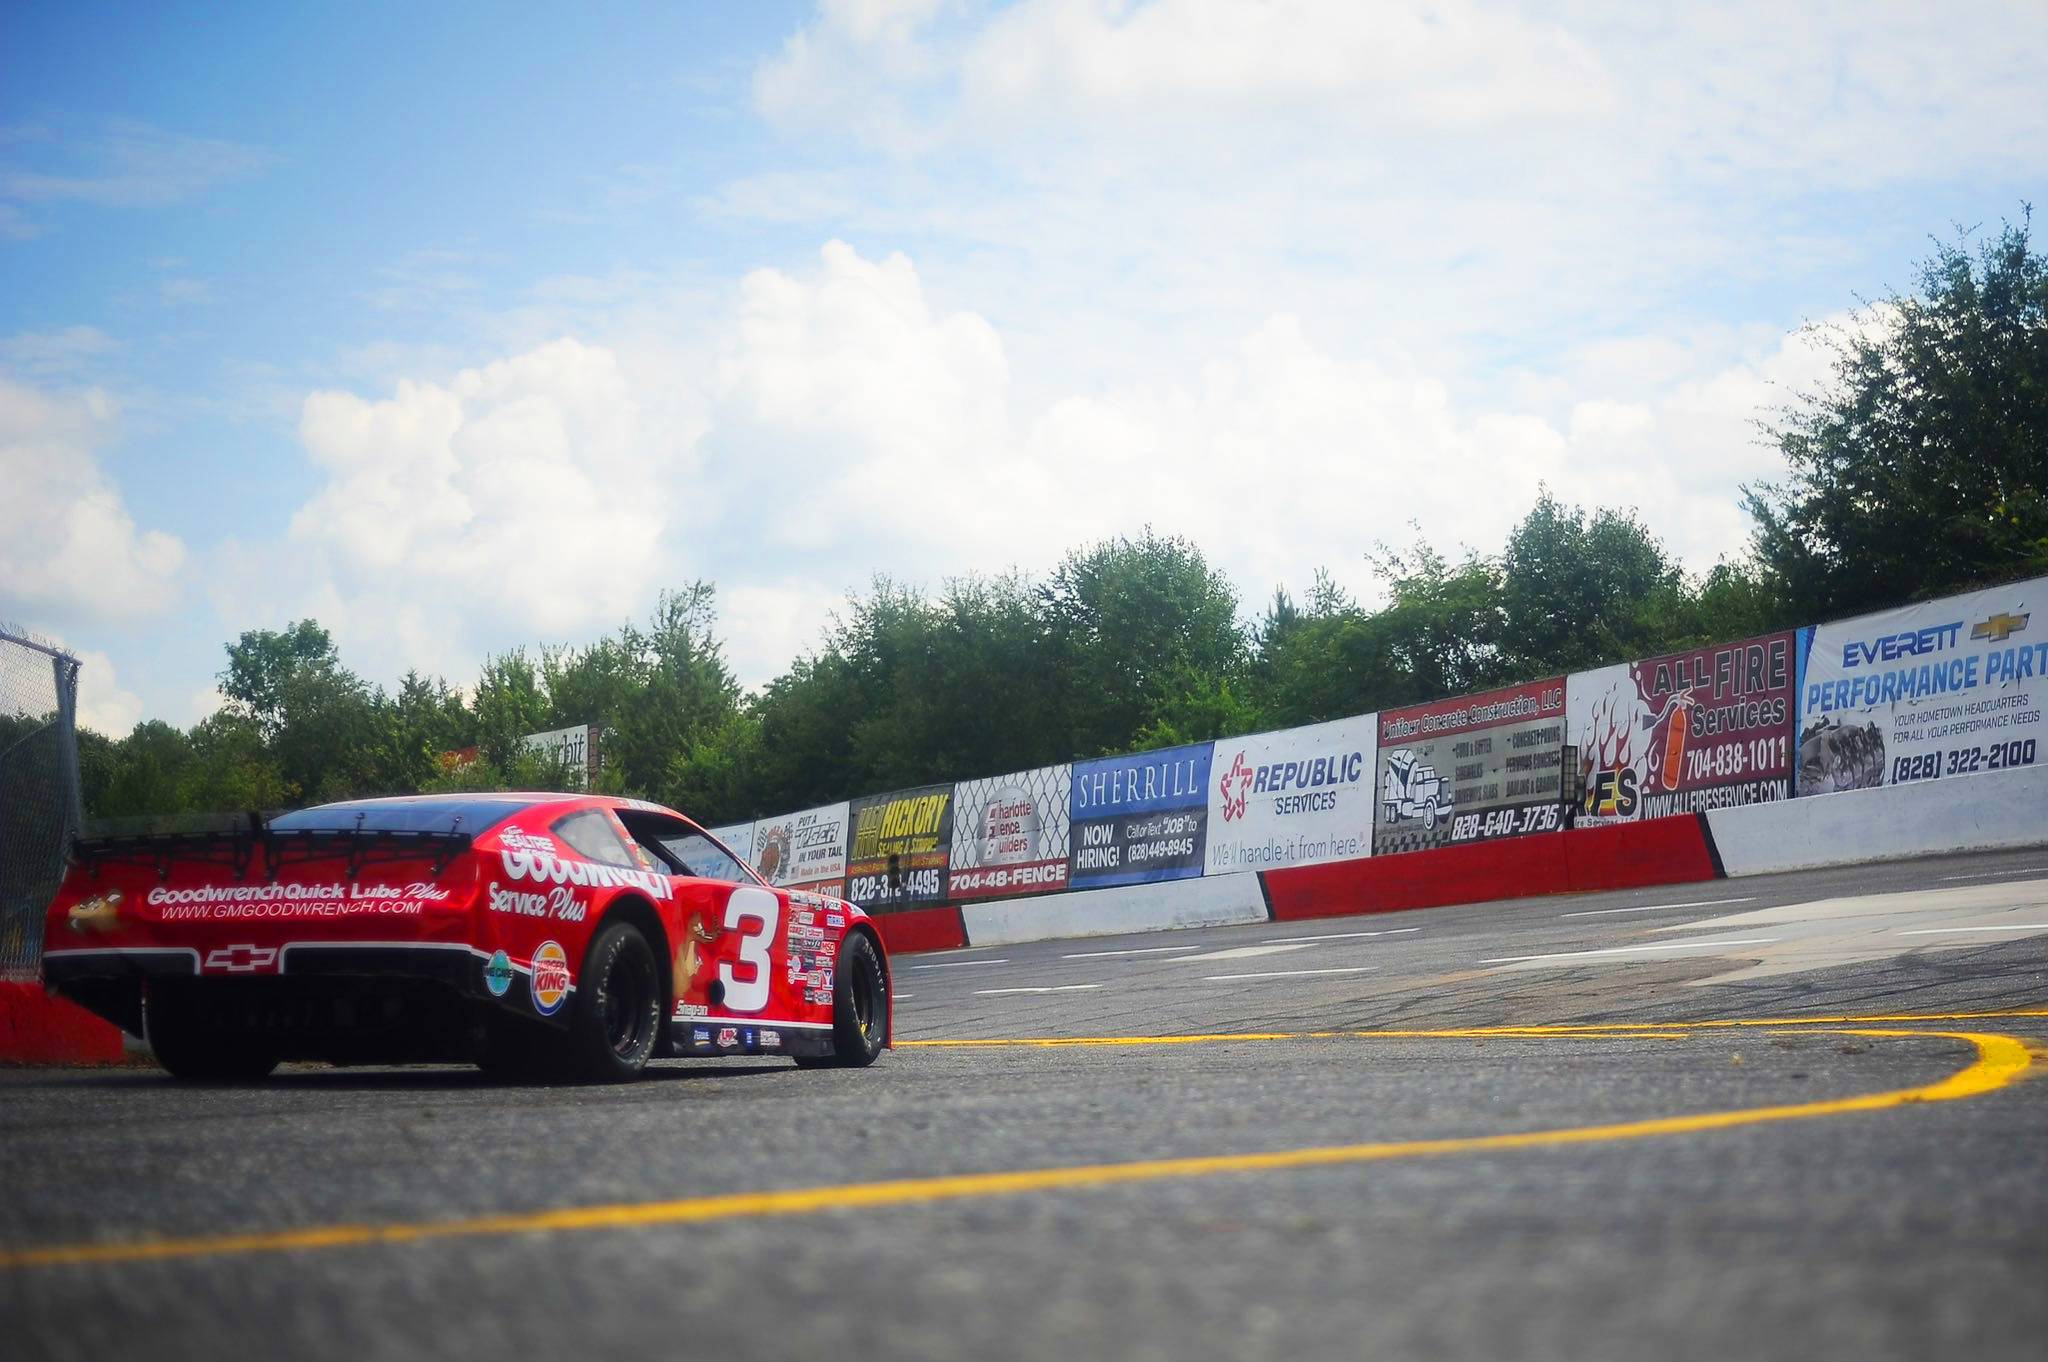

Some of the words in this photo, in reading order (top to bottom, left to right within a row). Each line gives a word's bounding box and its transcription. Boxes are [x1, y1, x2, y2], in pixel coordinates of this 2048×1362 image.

[1843, 621, 1964, 668] EVERETT
[1807, 655, 1980, 714] PERFORMANCE
[1383, 717, 1420, 741] Unifour
[1421, 710, 1468, 733] Concrete
[1470, 695, 1540, 725] Construction,
[1542, 688, 1562, 711] LLC
[1691, 696, 1785, 738] Services
[1894, 712, 1916, 727] YOUR
[1917, 705, 1963, 722] HOMETOWN
[1964, 694, 2029, 716] HEADQUARTERS
[1893, 730, 1909, 744] FOR
[1911, 728, 1925, 741] ALL
[1927, 724, 1949, 739] YOUR
[1950, 715, 2008, 736] PERFORMANCE
[2010, 710, 2041, 725] NEEDS
[1253, 752, 1362, 793] REPUBLIC
[1686, 736, 1786, 781] 704-838-1011
[1947, 739, 2037, 775] 322-2100
[1080, 760, 1198, 808] SHERRILL
[880, 794, 949, 839] HICKORY
[1275, 791, 1336, 815] SERVICES
[795, 822, 841, 849] TIGER
[798, 816, 810, 827] PUT
[812, 814, 817, 824] A
[1084, 824, 1114, 846] NOW
[1147, 822, 1161, 836] Text
[1189, 819, 1198, 831] to
[799, 852, 806, 862] IN
[808, 849, 826, 860] YOUR
[828, 846, 842, 857] TAIL
[1077, 846, 1120, 869] HIRING!
[1240, 838, 1282, 864] handle
[1286, 838, 1294, 861] it
[1299, 835, 1327, 859] from
[350, 883, 401, 899] Lube
[403, 883, 451, 900] Plus
[950, 863, 1067, 891] 704-48-FENCE
[161, 901, 423, 919] WWW.GMGOODWRENCH.COM
[489, 881, 546, 917] Service
[548, 886, 587, 922] Plus
[719, 888, 780, 1013] 3
[535, 972, 567, 991] KING
[675, 999, 708, 1016] Snap-on
